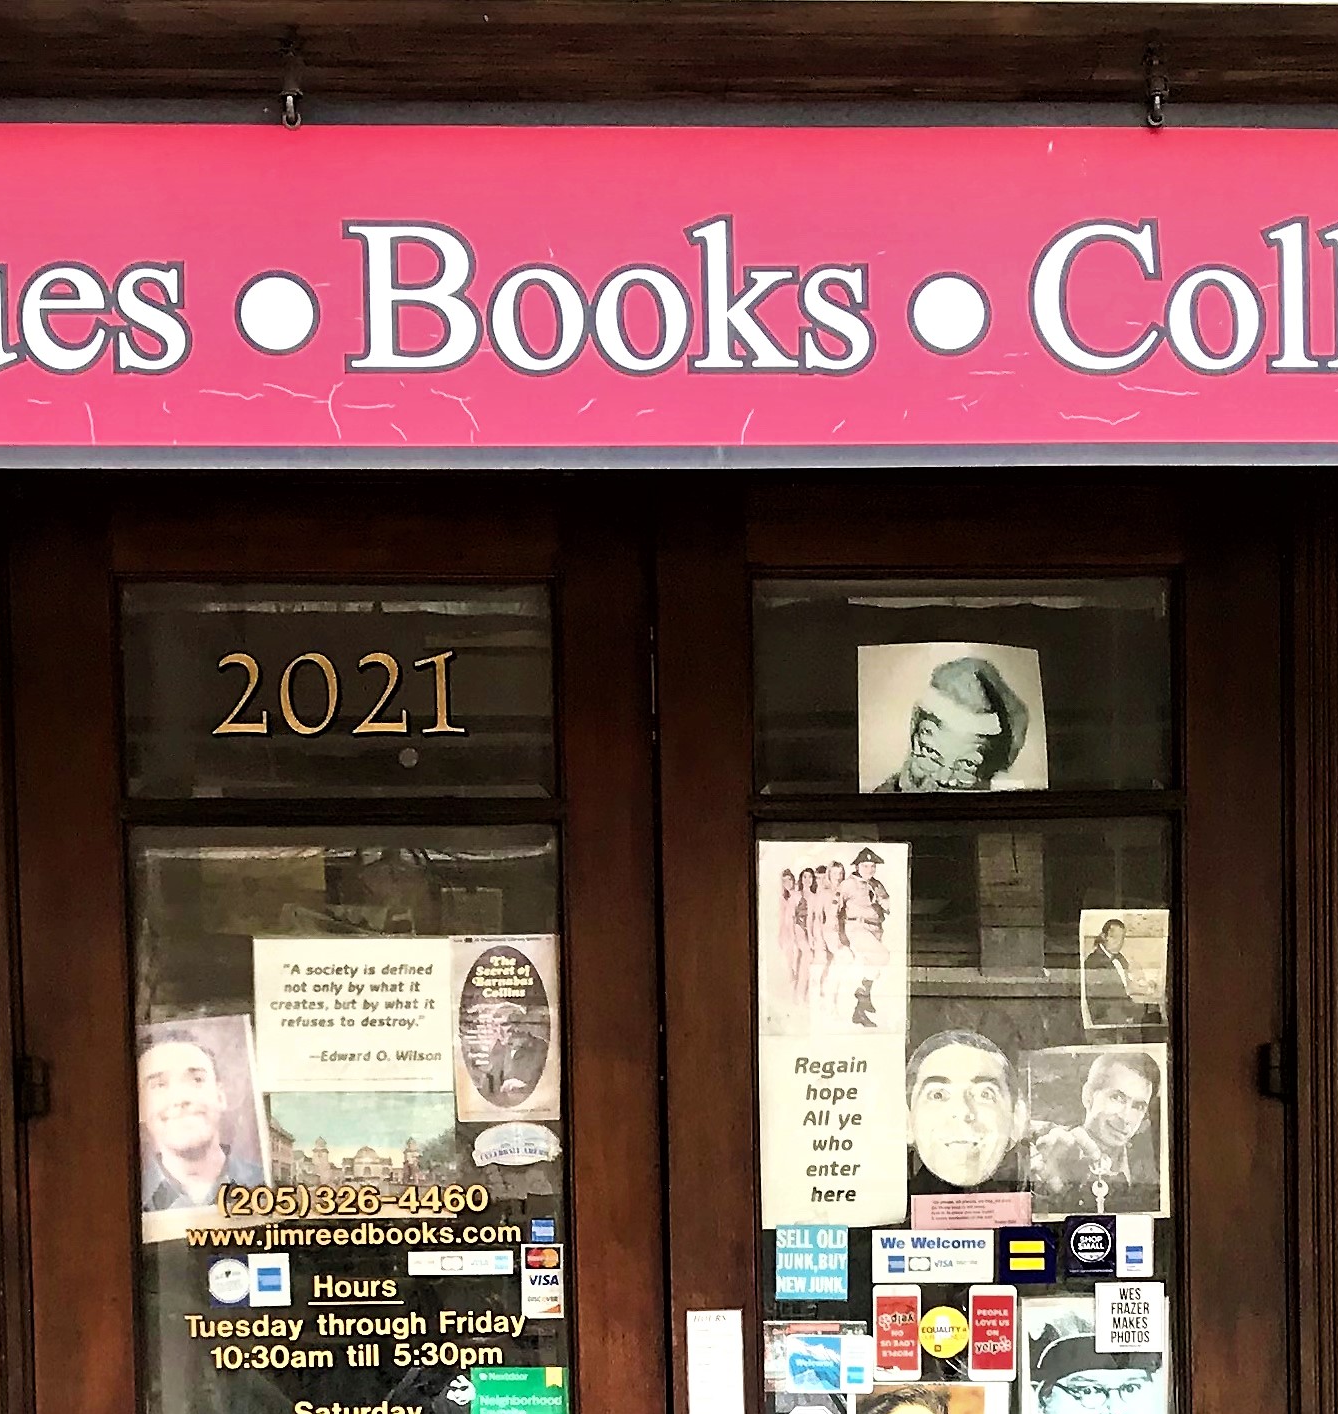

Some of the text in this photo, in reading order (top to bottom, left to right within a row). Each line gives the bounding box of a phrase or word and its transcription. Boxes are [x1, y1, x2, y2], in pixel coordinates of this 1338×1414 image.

[344, 214, 877, 376] Books
[211, 648, 469, 740] 2021
[490, 956, 516, 966] The
[306, 963, 358, 978] society
[363, 964, 375, 975] is
[381, 963, 433, 975] defined
[476, 965, 531, 977] Secret of
[472, 976, 534, 987] Barnabas
[284, 982, 421, 996] not only by what it
[482, 988, 526, 998] Collins
[270, 999, 435, 1012] creates, but by what it
[281, 1016, 335, 1028] refuses
[340, 1017, 355, 1027] to
[376, 1050, 391, 1062] O.
[396, 1050, 442, 1061] Wilson
[794, 1056, 868, 1079] Regain
[806, 1084, 859, 1105] hope
[802, 1109, 863, 1130] All ye
[812, 1136, 853, 1152] who
[806, 1161, 861, 1178] enter
[810, 1185, 857, 1203] here
[186, 1221, 522, 1251] www.jimreedbooks.com
[776, 1229, 847, 1249] SELL OLD
[880, 1236, 986, 1249] We Welcome
[934, 1259, 954, 1268] VISA
[313, 1275, 398, 1299] Hours
[529, 1275, 559, 1286] VISA
[777, 1277, 806, 1293] NEW
[1119, 1288, 1141, 1300] WES
[1111, 1302, 1150, 1314] FRAZER
[185, 1310, 527, 1341] Tuesday through Friday
[1113, 1317, 1148, 1329] MAKES
[1111, 1331, 1150, 1343] PHOTOS
[975, 1341, 999, 1352] yelp
[211, 1343, 504, 1370] 10:30am till 5:30pm
[488, 1373, 528, 1381] Nextdoor
[479, 1396, 562, 1407] Neighborhood
